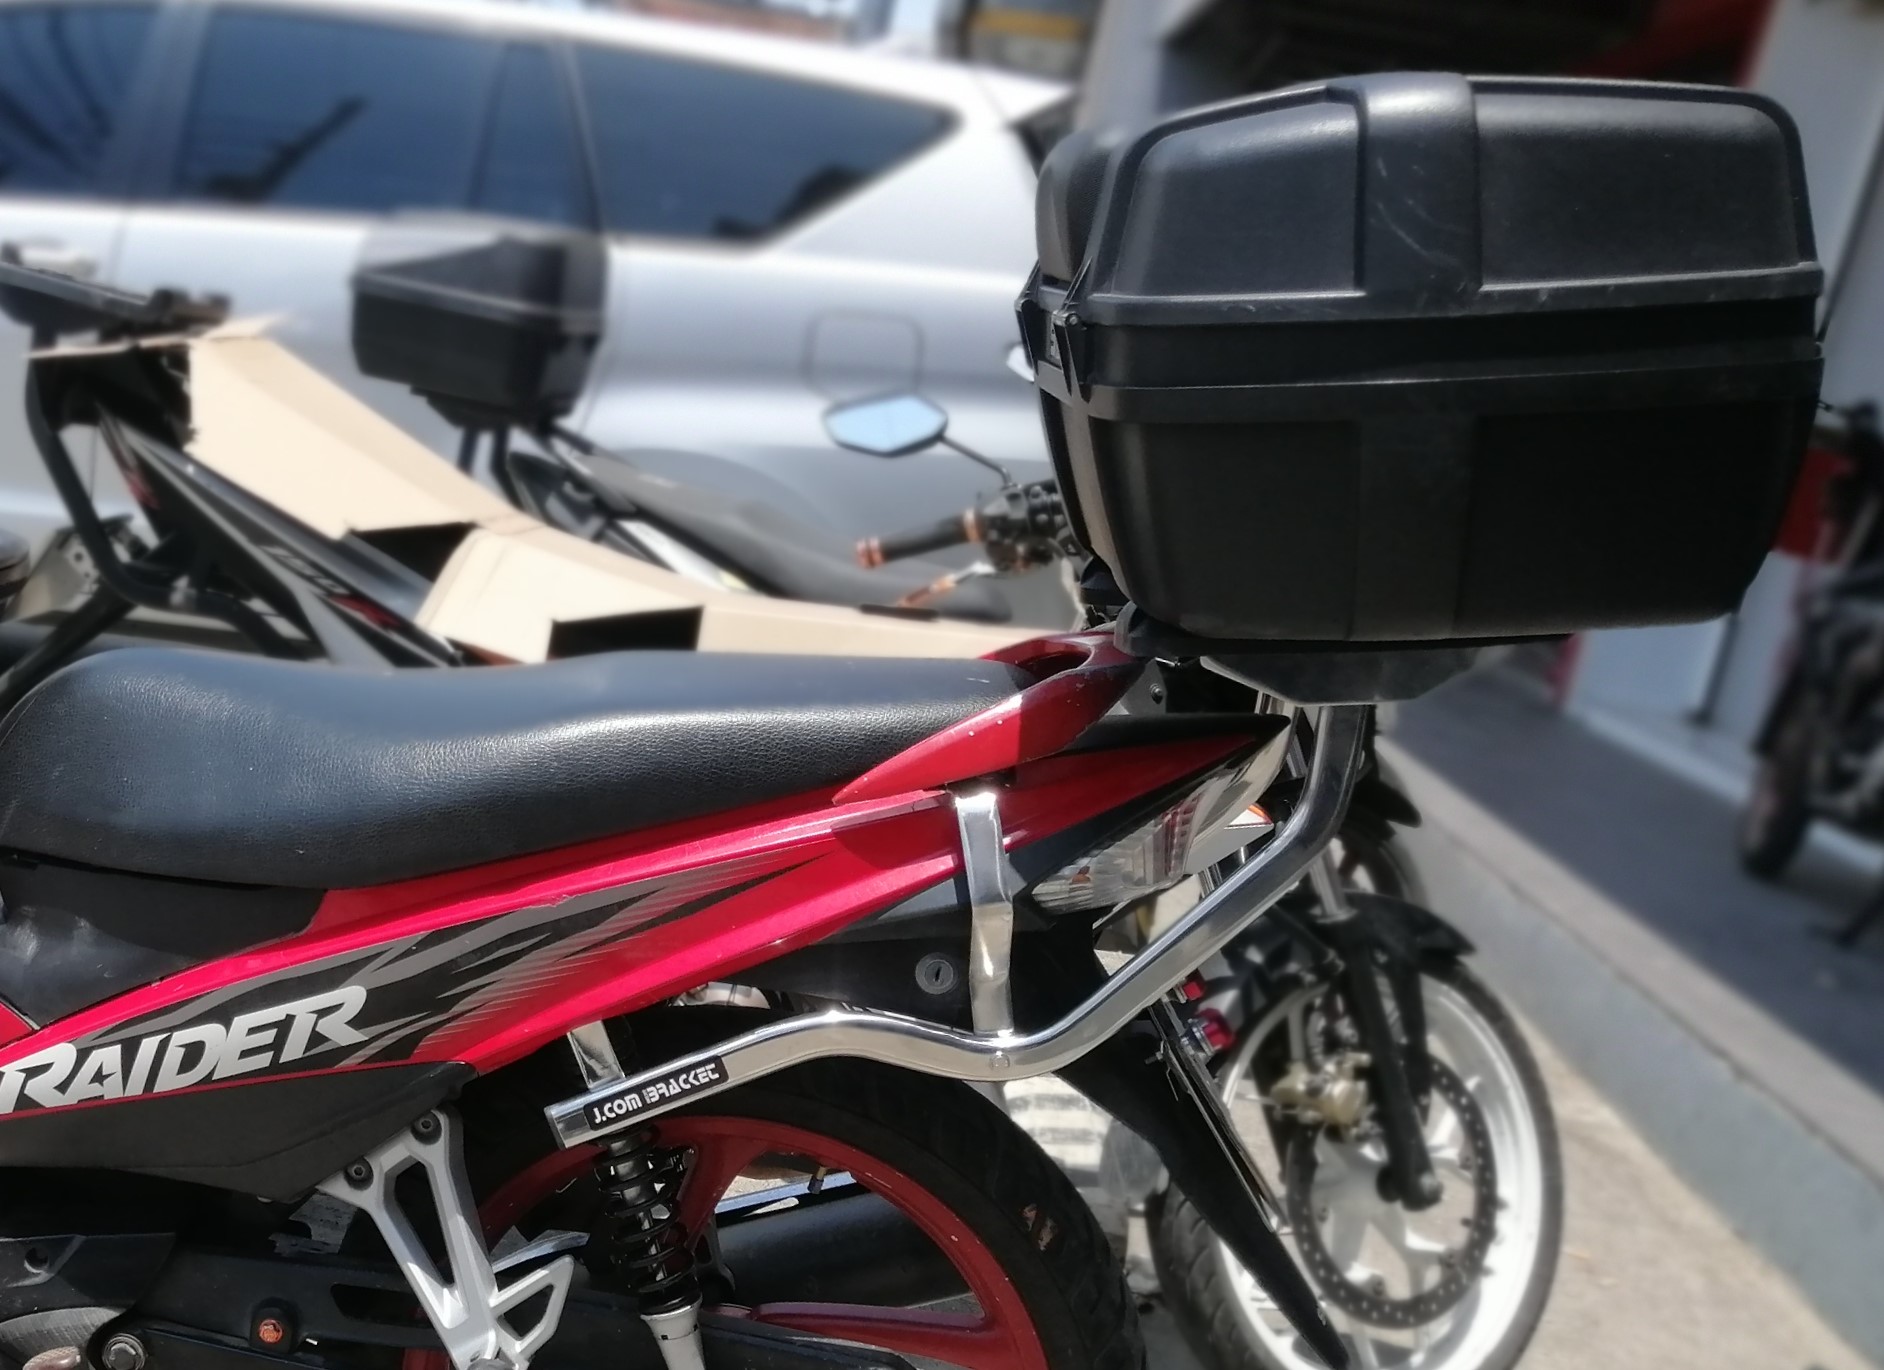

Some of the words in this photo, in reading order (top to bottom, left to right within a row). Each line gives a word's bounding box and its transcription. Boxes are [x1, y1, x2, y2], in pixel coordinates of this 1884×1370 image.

[0, 985, 370, 1114] RAIDER
[592, 1094, 643, 1124] J.COM
[643, 1063, 720, 1104] BRACKET
